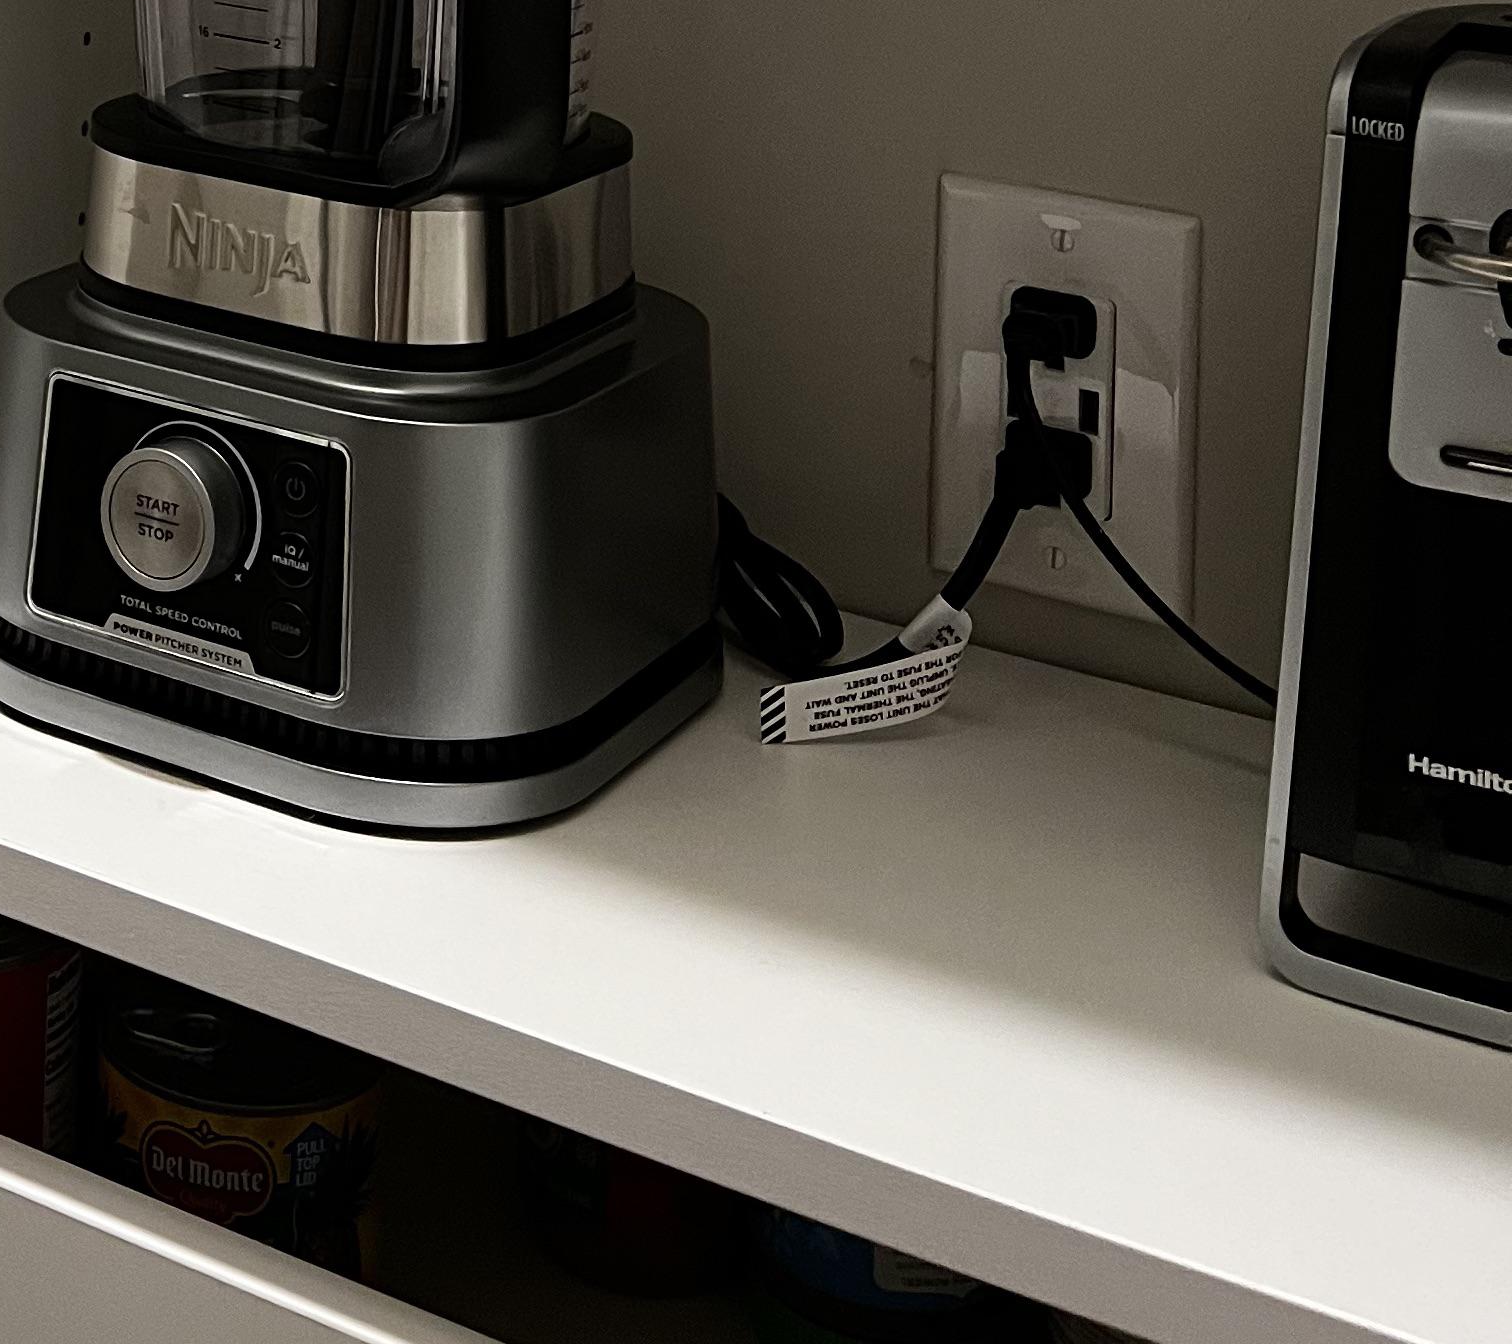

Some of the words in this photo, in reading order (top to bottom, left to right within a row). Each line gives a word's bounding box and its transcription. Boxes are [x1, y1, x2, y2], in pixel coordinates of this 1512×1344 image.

[199, 25, 209, 38] 16
[274, 38, 282, 50] 2
[1351, 115, 1405, 142] LOCKED
[168, 202, 311, 298] NINJA
[136, 494, 180, 517] START
[138, 523, 174, 542] STOP
[272, 554, 310, 572] manual
[120, 594, 152, 614] TOTAL
[155, 605, 189, 623] SPEED
[192, 616, 243, 640] CONTROL
[113, 621, 153, 642] POWER
[155, 629, 198, 655] PITCHER
[201, 648, 242, 668] SYSTEM
[880, 672, 895, 683] TO
[860, 687, 885, 700] UNIT
[887, 681, 907, 694] THE
[805, 696, 832, 710] WAIT
[834, 692, 858, 705] AND
[896, 693, 915, 704] THE
[913, 699, 931, 712] THE
[844, 697, 893, 715] THERMAL
[888, 705, 911, 719] UNIT
[814, 709, 841, 720] FUSE
[851, 712, 884, 725] LOSES
[809, 719, 848, 732] POWER
[296, 1139, 327, 1154] PULL
[151, 1145, 184, 1181] Del
[188, 1158, 264, 1193] Monte
[296, 1154, 321, 1171] TOP
[295, 1171, 318, 1187] LID
